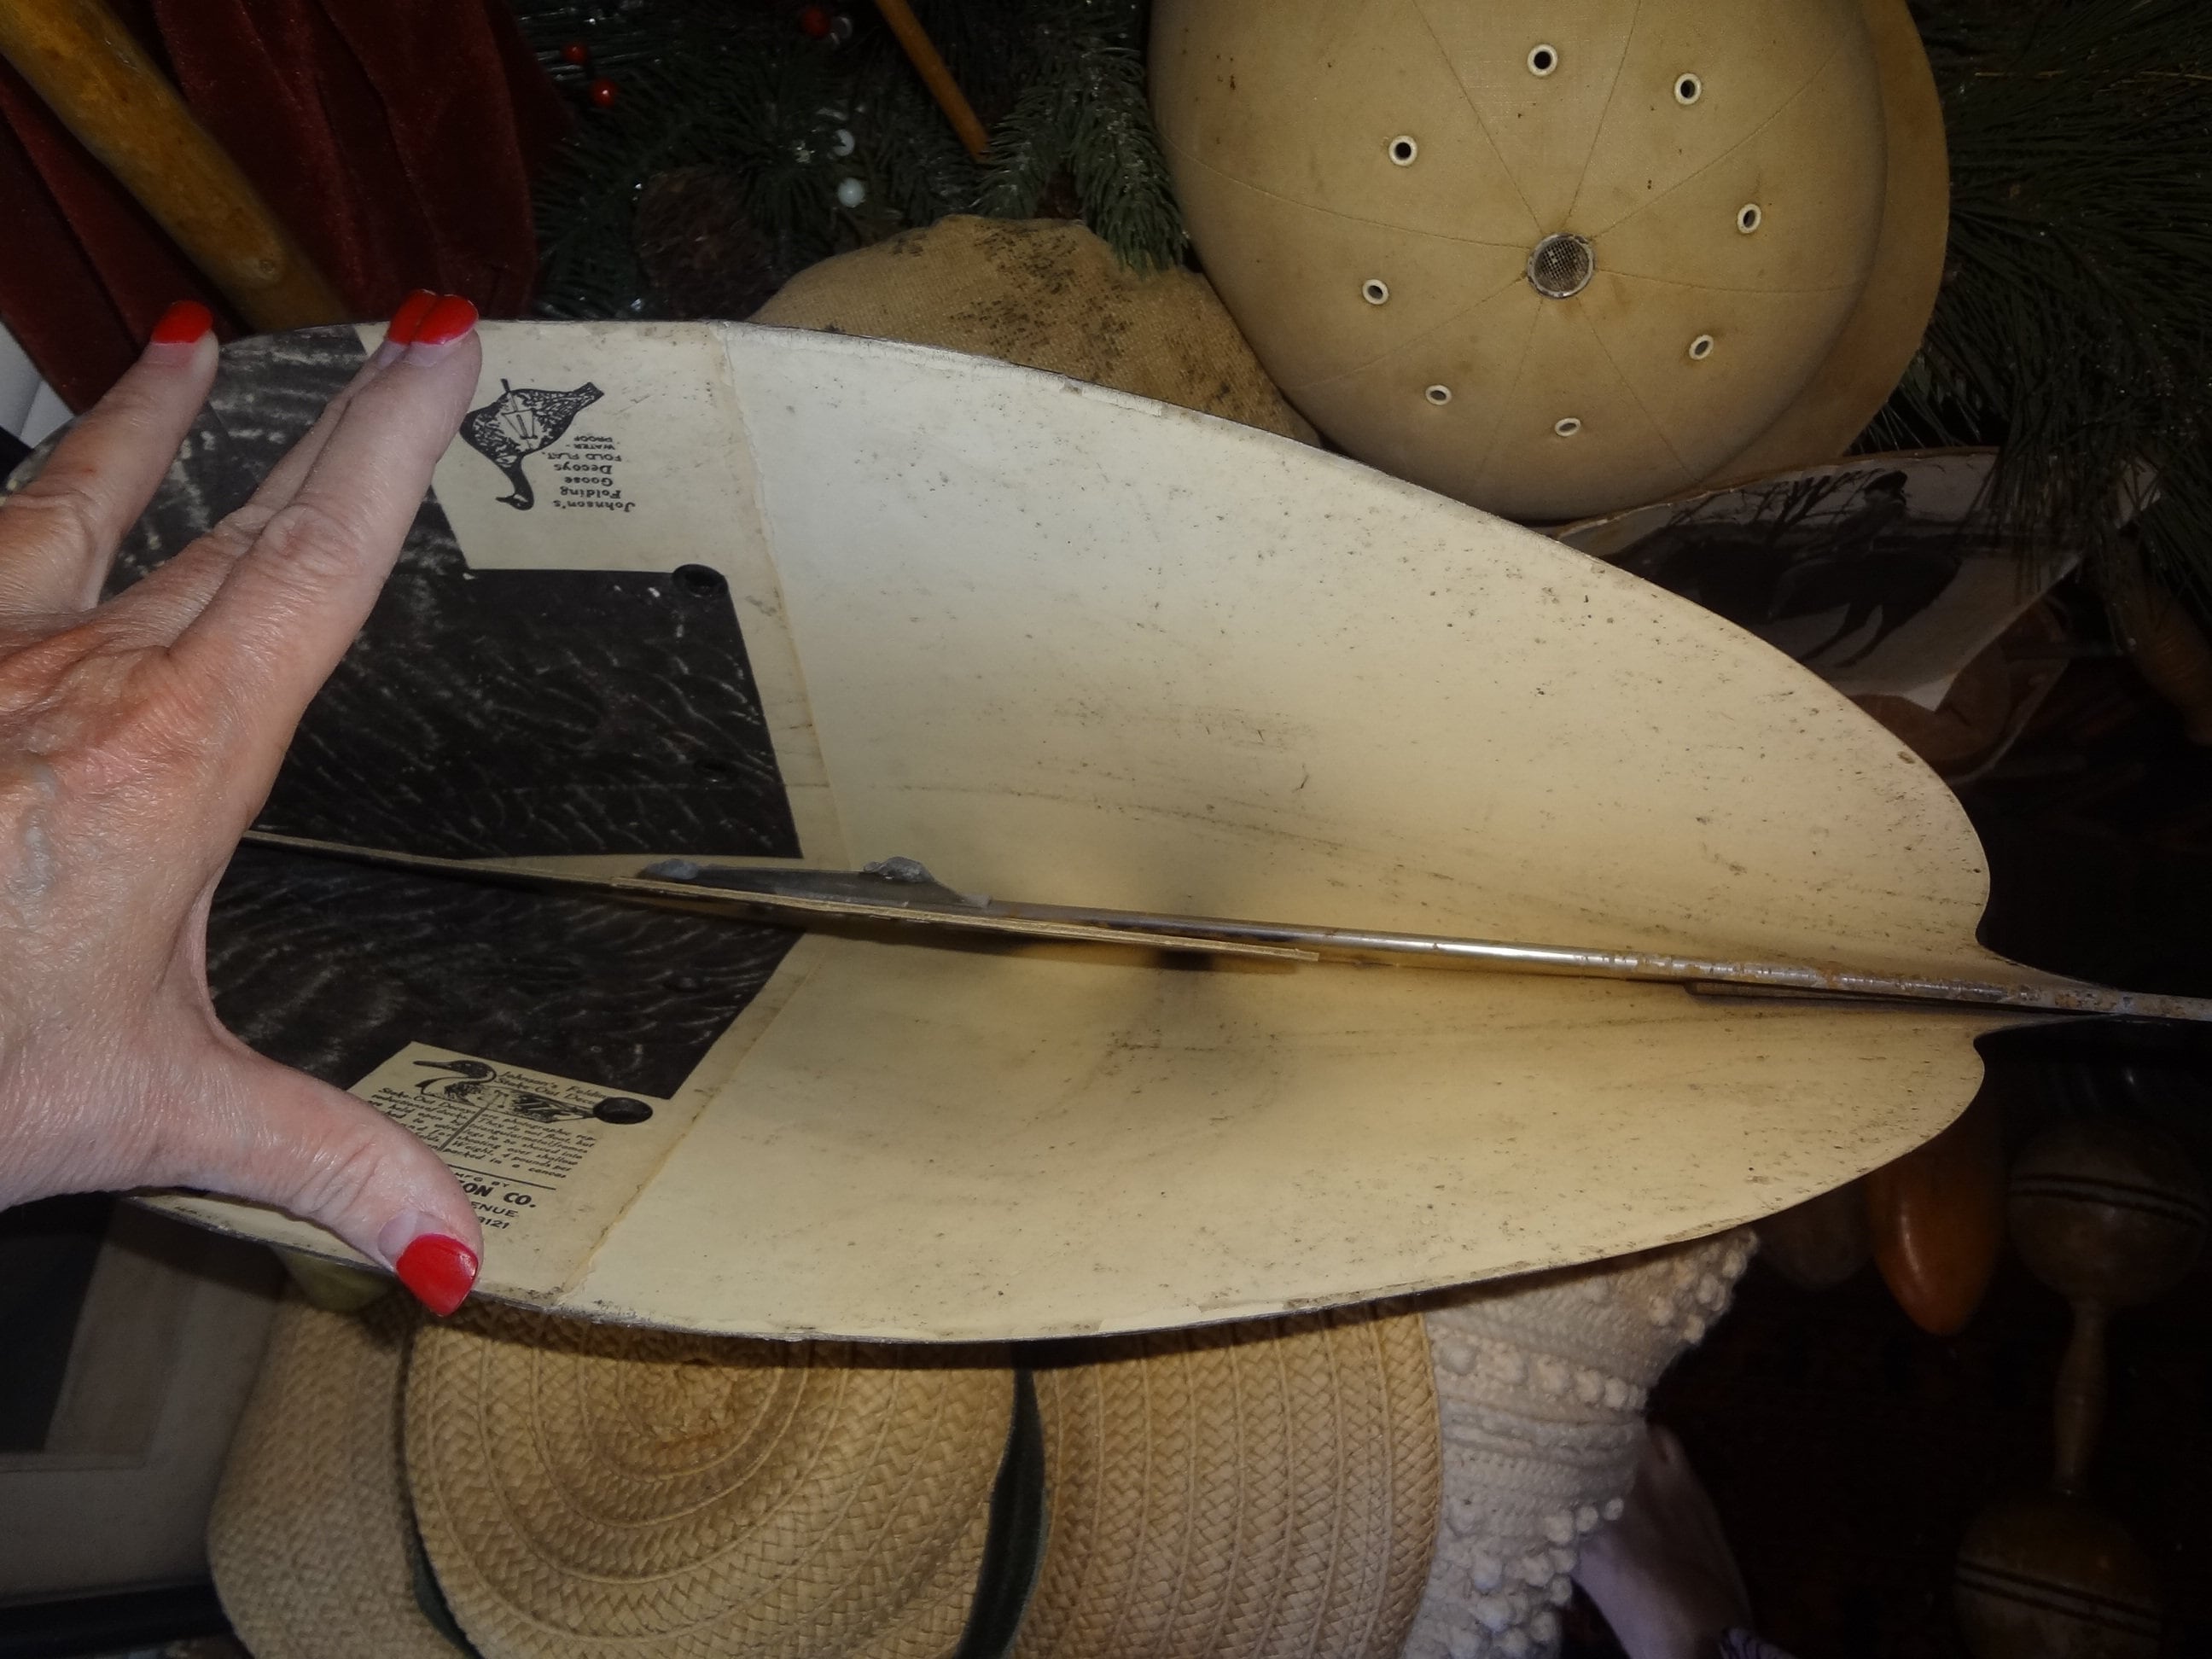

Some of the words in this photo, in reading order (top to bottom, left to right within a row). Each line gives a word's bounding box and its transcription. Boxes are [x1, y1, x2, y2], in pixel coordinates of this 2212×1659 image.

[542, 451, 579, 460] FLAT.
[585, 453, 621, 462] FOLD
[554, 462, 612, 474] Decoys
[564, 476, 613, 486] Goose
[560, 486, 621, 499] Folding
[553, 500, 636, 512] Johnson's
[498, 1071, 558, 1089] Johnson's
[565, 1086, 607, 1099] Foldin
[388, 1104, 415, 1114] held
[478, 1117, 504, 1128] They
[457, 1136, 501, 1150] shooting
[536, 1154, 578, 1166] shallow
[522, 1144, 561, 1154] shoved
[443, 1148, 486, 1161] packed
[528, 1167, 567, 1179] canvas
[511, 1156, 550, 1167] pounds
[459, 1179, 494, 1197] ON
[504, 1192, 537, 1208] CO.
[470, 1202, 519, 1218] ENUE
